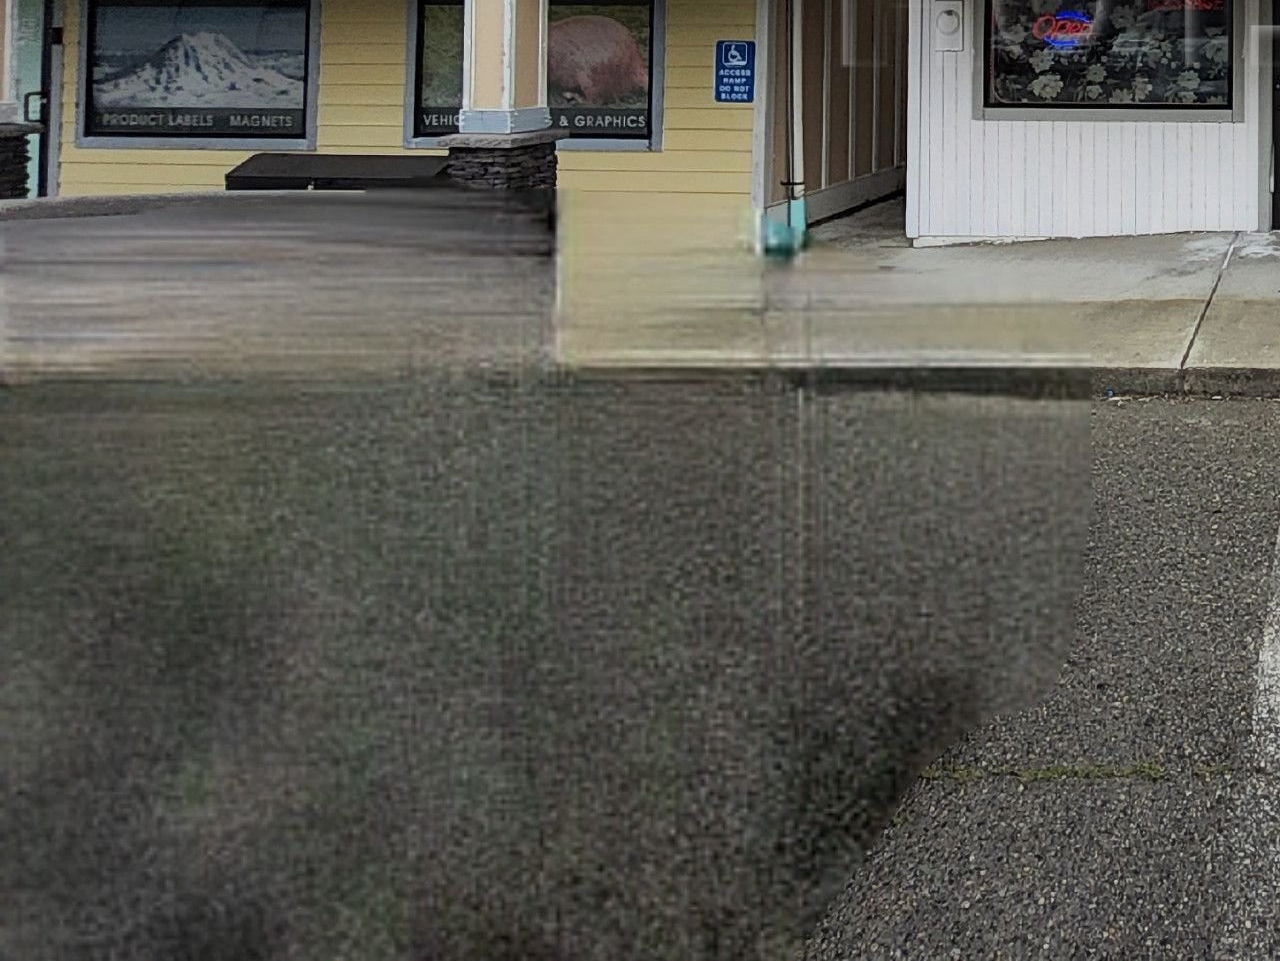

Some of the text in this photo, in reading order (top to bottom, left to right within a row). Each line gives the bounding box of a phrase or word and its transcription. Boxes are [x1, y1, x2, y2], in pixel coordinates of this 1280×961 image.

[102, 114, 293, 127] PRODUCT LABELS MAGNETS
[423, 114, 460, 126] VEHIC
[559, 116, 569, 127] &
[574, 115, 646, 127] GRAPHICS
